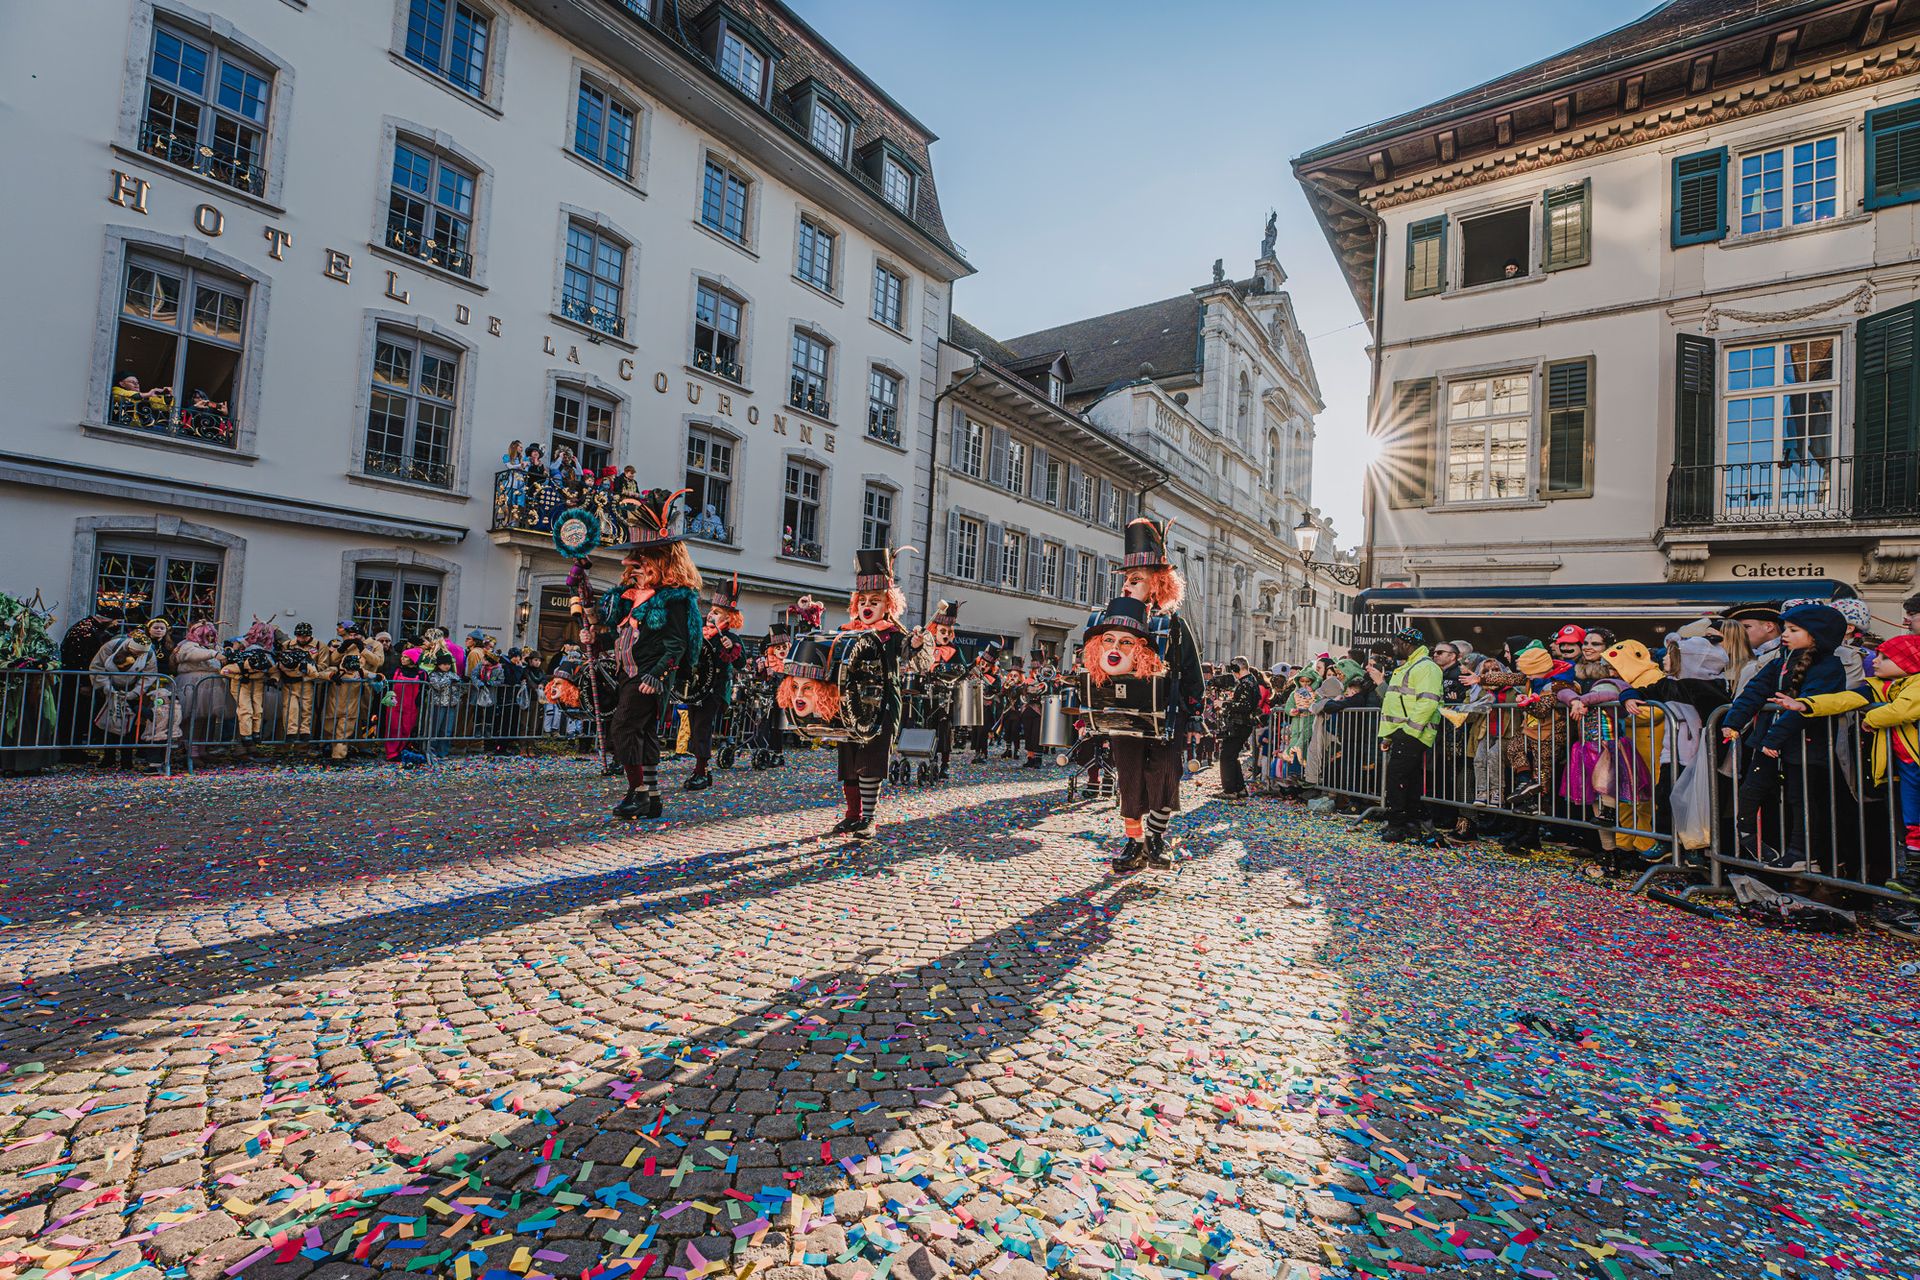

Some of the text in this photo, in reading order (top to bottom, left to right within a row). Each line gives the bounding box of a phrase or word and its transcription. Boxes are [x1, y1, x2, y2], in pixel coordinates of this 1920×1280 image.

[108, 168, 836, 454] HOTEL DE LA COURONNE
[1731, 562, 1825, 578] Cafeteria
[1354, 613, 1403, 634] MIETEN
